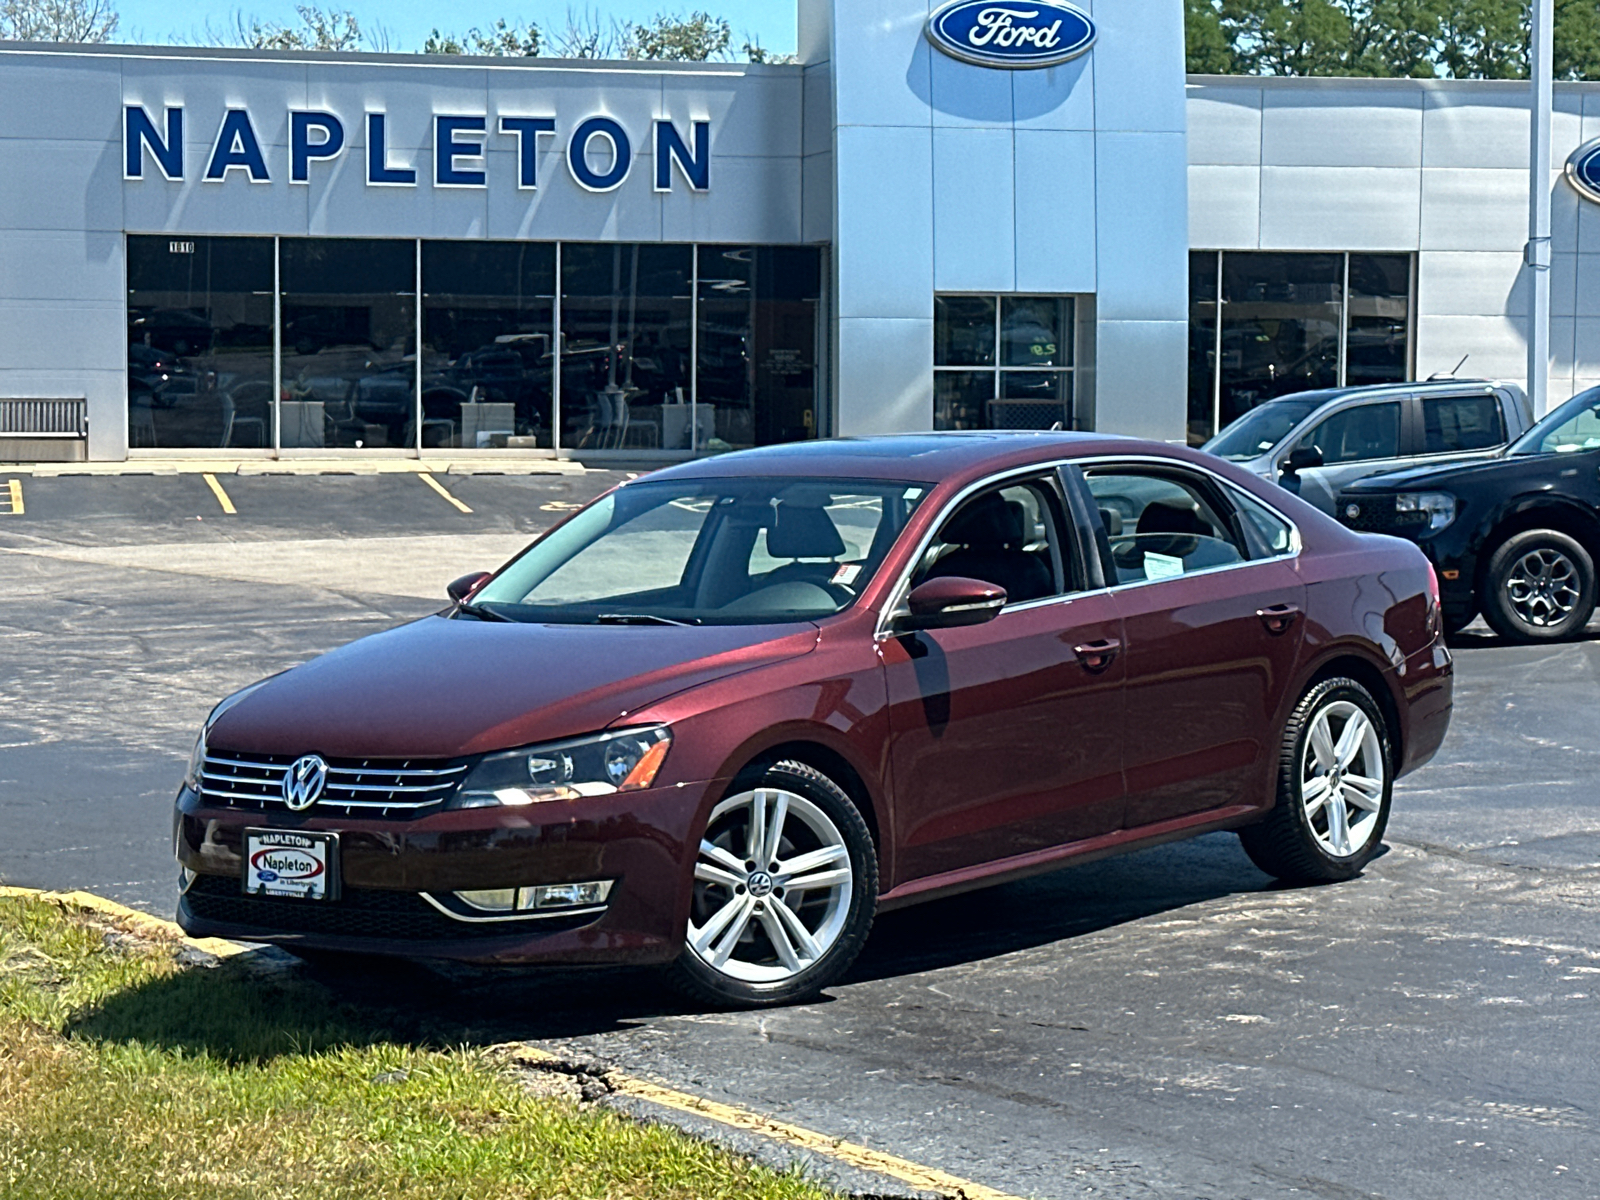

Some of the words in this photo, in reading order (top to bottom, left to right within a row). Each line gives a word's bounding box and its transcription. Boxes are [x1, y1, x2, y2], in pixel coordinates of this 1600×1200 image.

[969, 7, 1063, 48] Ford
[122, 103, 711, 193] NAPLETON
[262, 834, 312, 848] NAPLETON
[263, 854, 313, 873] Napleton
